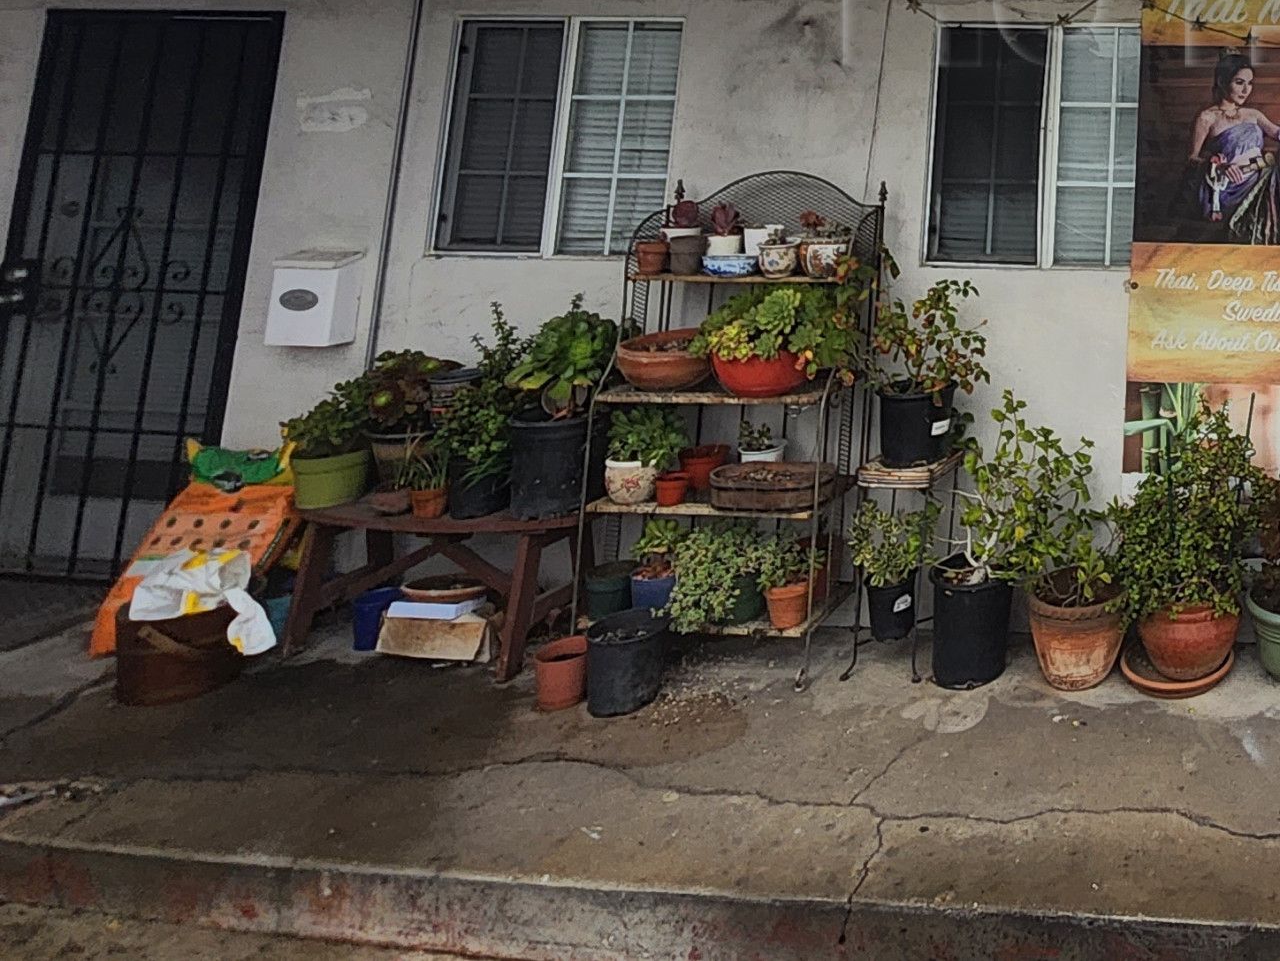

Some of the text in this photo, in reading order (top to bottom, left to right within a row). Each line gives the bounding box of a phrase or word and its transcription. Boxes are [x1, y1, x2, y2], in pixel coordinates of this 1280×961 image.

[1154, 268, 1200, 291] Thai,
[1207, 269, 1255, 298] Deep
[1151, 328, 1188, 351] Ask
[1193, 329, 1251, 353] About
